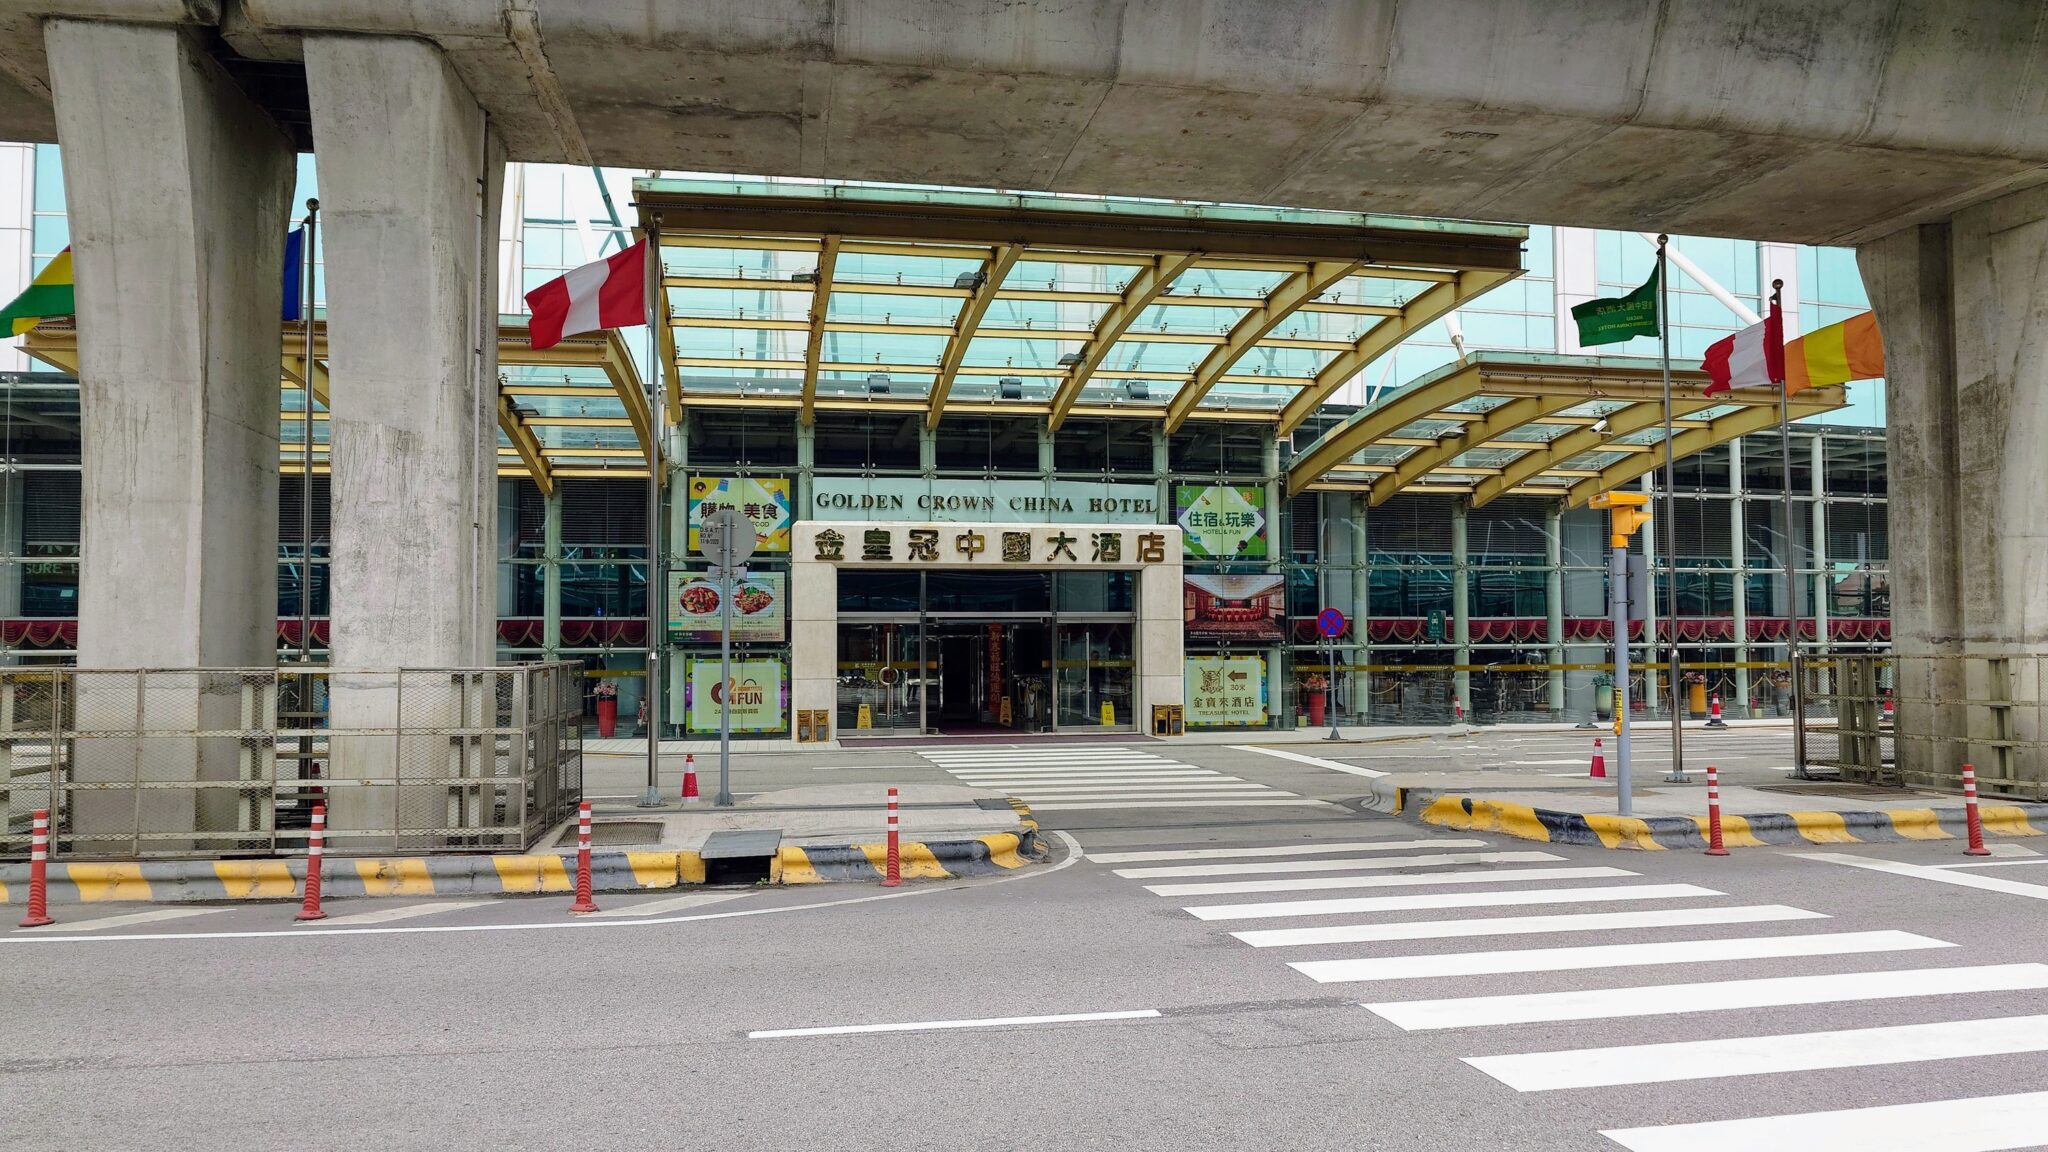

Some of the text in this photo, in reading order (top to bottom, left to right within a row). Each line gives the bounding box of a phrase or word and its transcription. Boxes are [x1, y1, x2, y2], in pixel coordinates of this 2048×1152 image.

[816, 492, 1157, 514] GOLDEN CROWN CHINA HOTEL
[1188, 511, 1256, 528] 住宿&玩樂
[814, 527, 1166, 563] 金皇冠中國大酒店
[737, 692, 763, 705] FUN
[1193, 696, 1255, 708] 金寶來酒店
